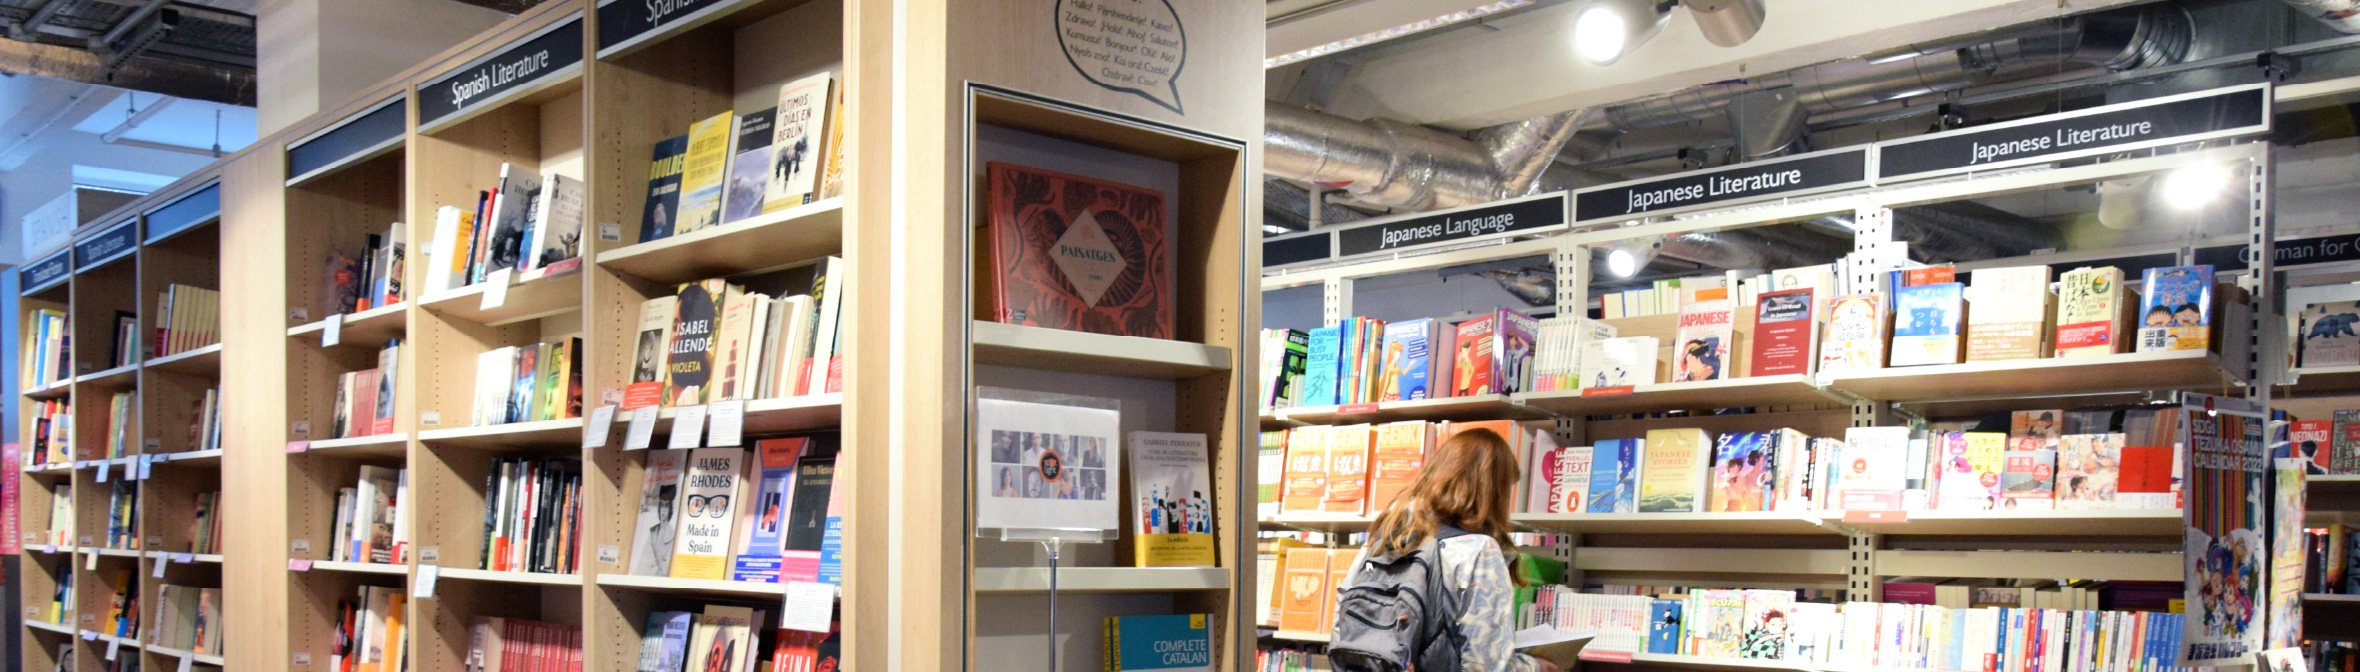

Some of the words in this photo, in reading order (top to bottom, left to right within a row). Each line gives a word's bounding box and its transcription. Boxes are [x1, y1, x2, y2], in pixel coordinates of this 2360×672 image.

[452, 69, 490, 110] Spanish
[492, 50, 549, 87] Literature
[1971, 137, 2051, 164] Japanese
[2056, 117, 2151, 149] Literature
[650, 152, 687, 182] BOULDE
[1627, 184, 1704, 213] Japanese
[1709, 166, 1801, 196] Literature
[1380, 223, 1441, 248] Japanese
[1446, 211, 1515, 236] Language
[1061, 244, 1116, 263] PAISATGES
[2238, 245, 2313, 264] Gman
[2320, 239, 2349, 256] for
[2079, 272, 2090, 300] 日本
[1486, 318, 1493, 333] 2
[1679, 310, 1731, 328] JAPANESE
[676, 319, 709, 336] ISABEL
[670, 337, 712, 354] ALLENDE
[1310, 353, 1335, 362] PEOPLE
[672, 361, 701, 374] VIOLETA
[2290, 430, 2328, 443] NEONAZI
[1650, 450, 1691, 458] JAPANESE
[1653, 458, 1688, 466] STORIES
[2194, 452, 2240, 471] CALENDAR
[2242, 457, 2263, 472] 2022
[697, 457, 731, 471] JAMES
[1566, 461, 1590, 473] TEXT
[690, 475, 732, 488] RHODES
[1549, 449, 1566, 513] APANESE
[686, 524, 710, 537] Made
[711, 524, 719, 537] in
[688, 540, 713, 555] Spain
[1154, 639, 1207, 653] COMPLETE
[1162, 651, 1207, 665] CATALAN
